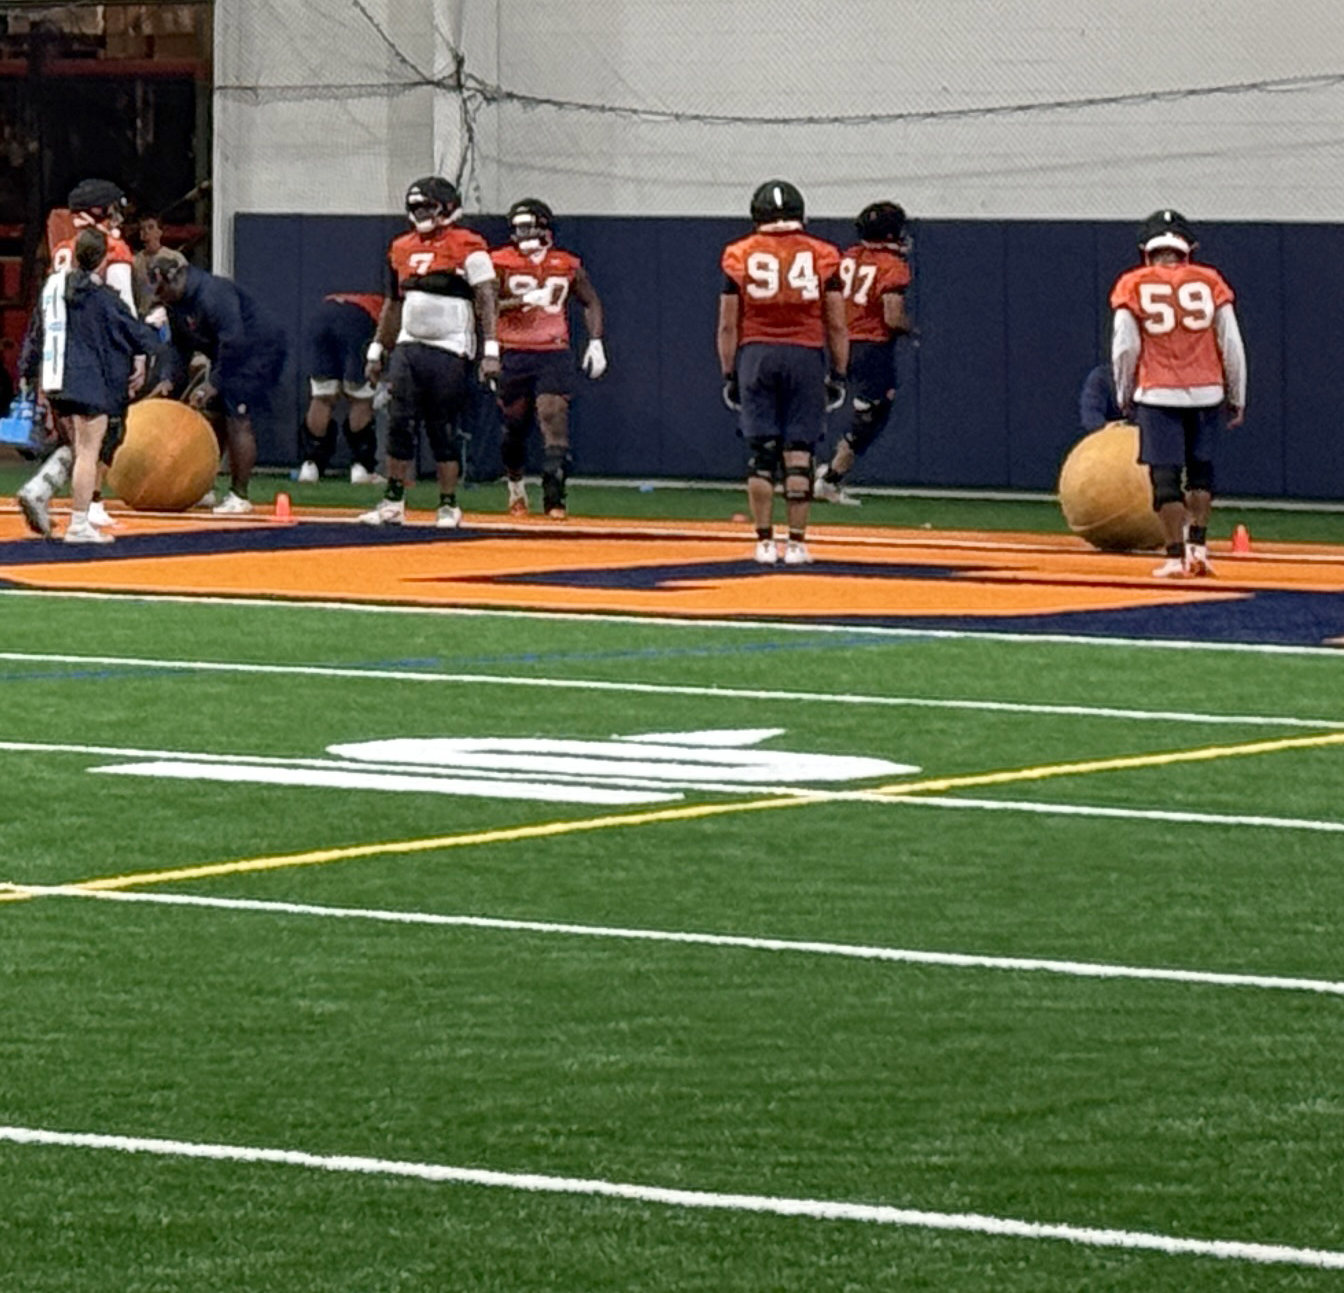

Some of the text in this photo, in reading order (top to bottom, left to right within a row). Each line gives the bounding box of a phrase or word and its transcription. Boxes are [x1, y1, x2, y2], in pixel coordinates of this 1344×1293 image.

[746, 251, 820, 300] 94
[839, 257, 878, 306] 97
[1139, 281, 1214, 334] 59
